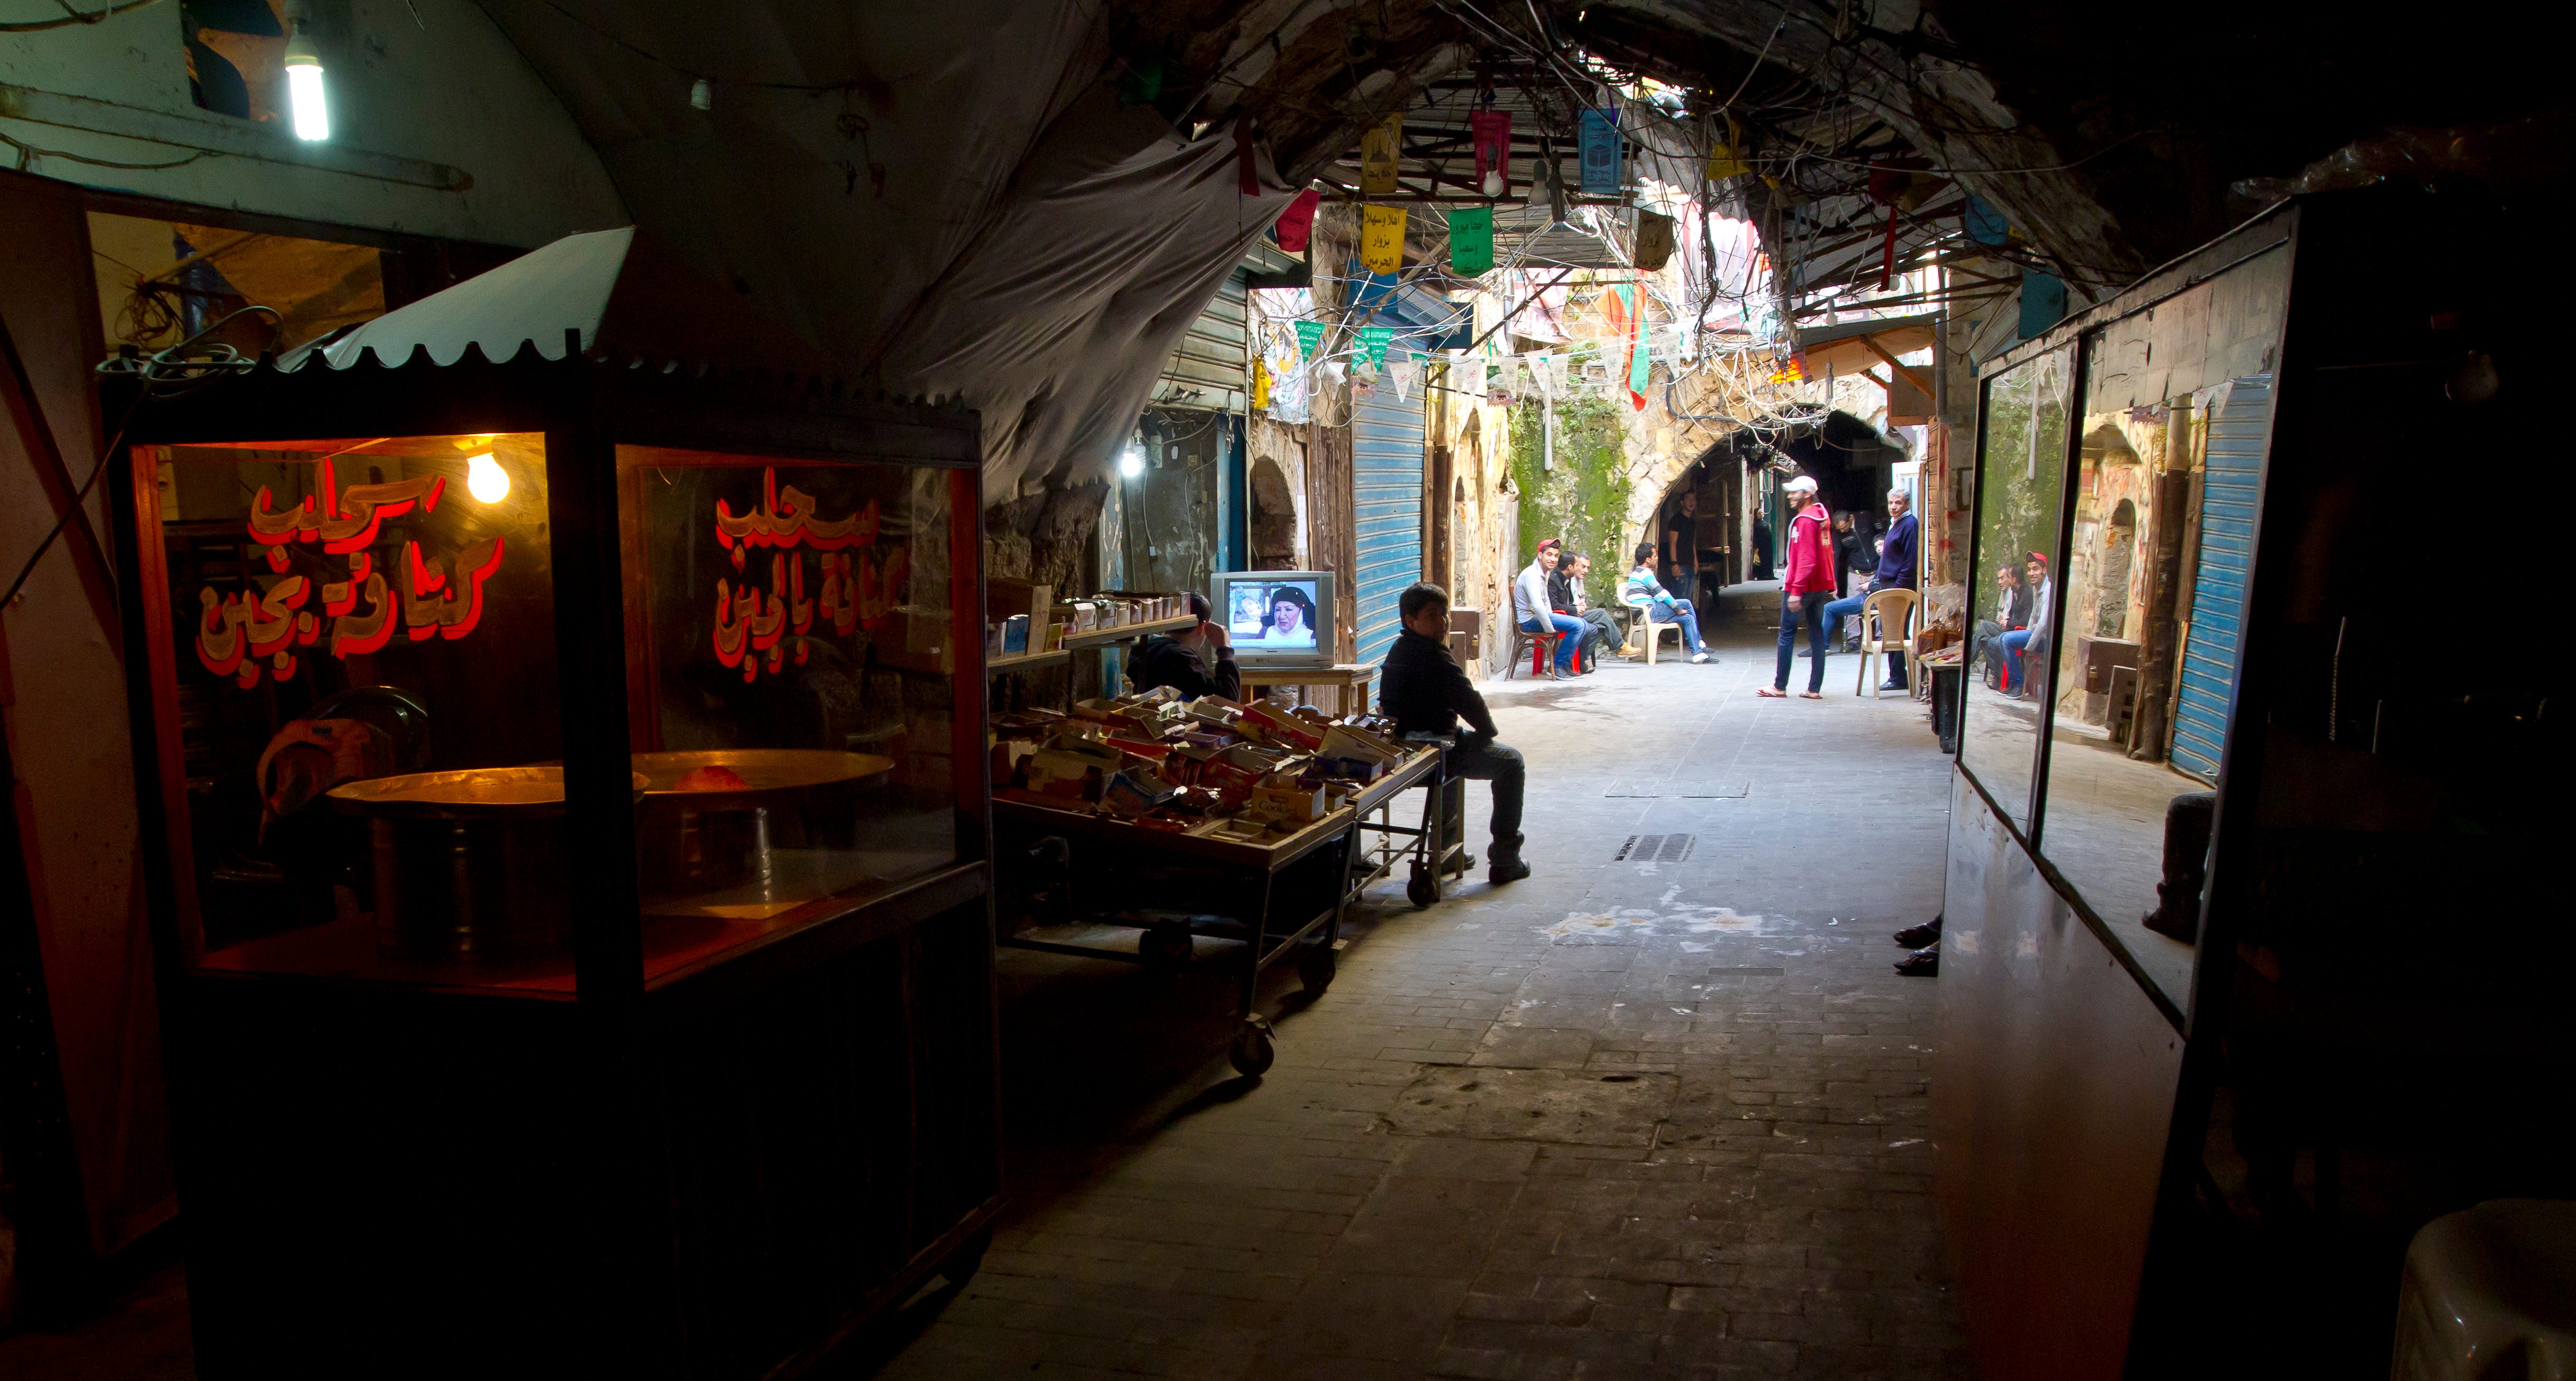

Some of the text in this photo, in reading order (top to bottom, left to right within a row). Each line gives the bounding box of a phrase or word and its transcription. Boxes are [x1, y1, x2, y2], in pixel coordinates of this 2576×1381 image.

[1373, 234, 1390, 249] بزوار
[247, 457, 446, 574] سحلب
[716, 466, 880, 574] سحلب
[331, 536, 505, 660] كنافة
